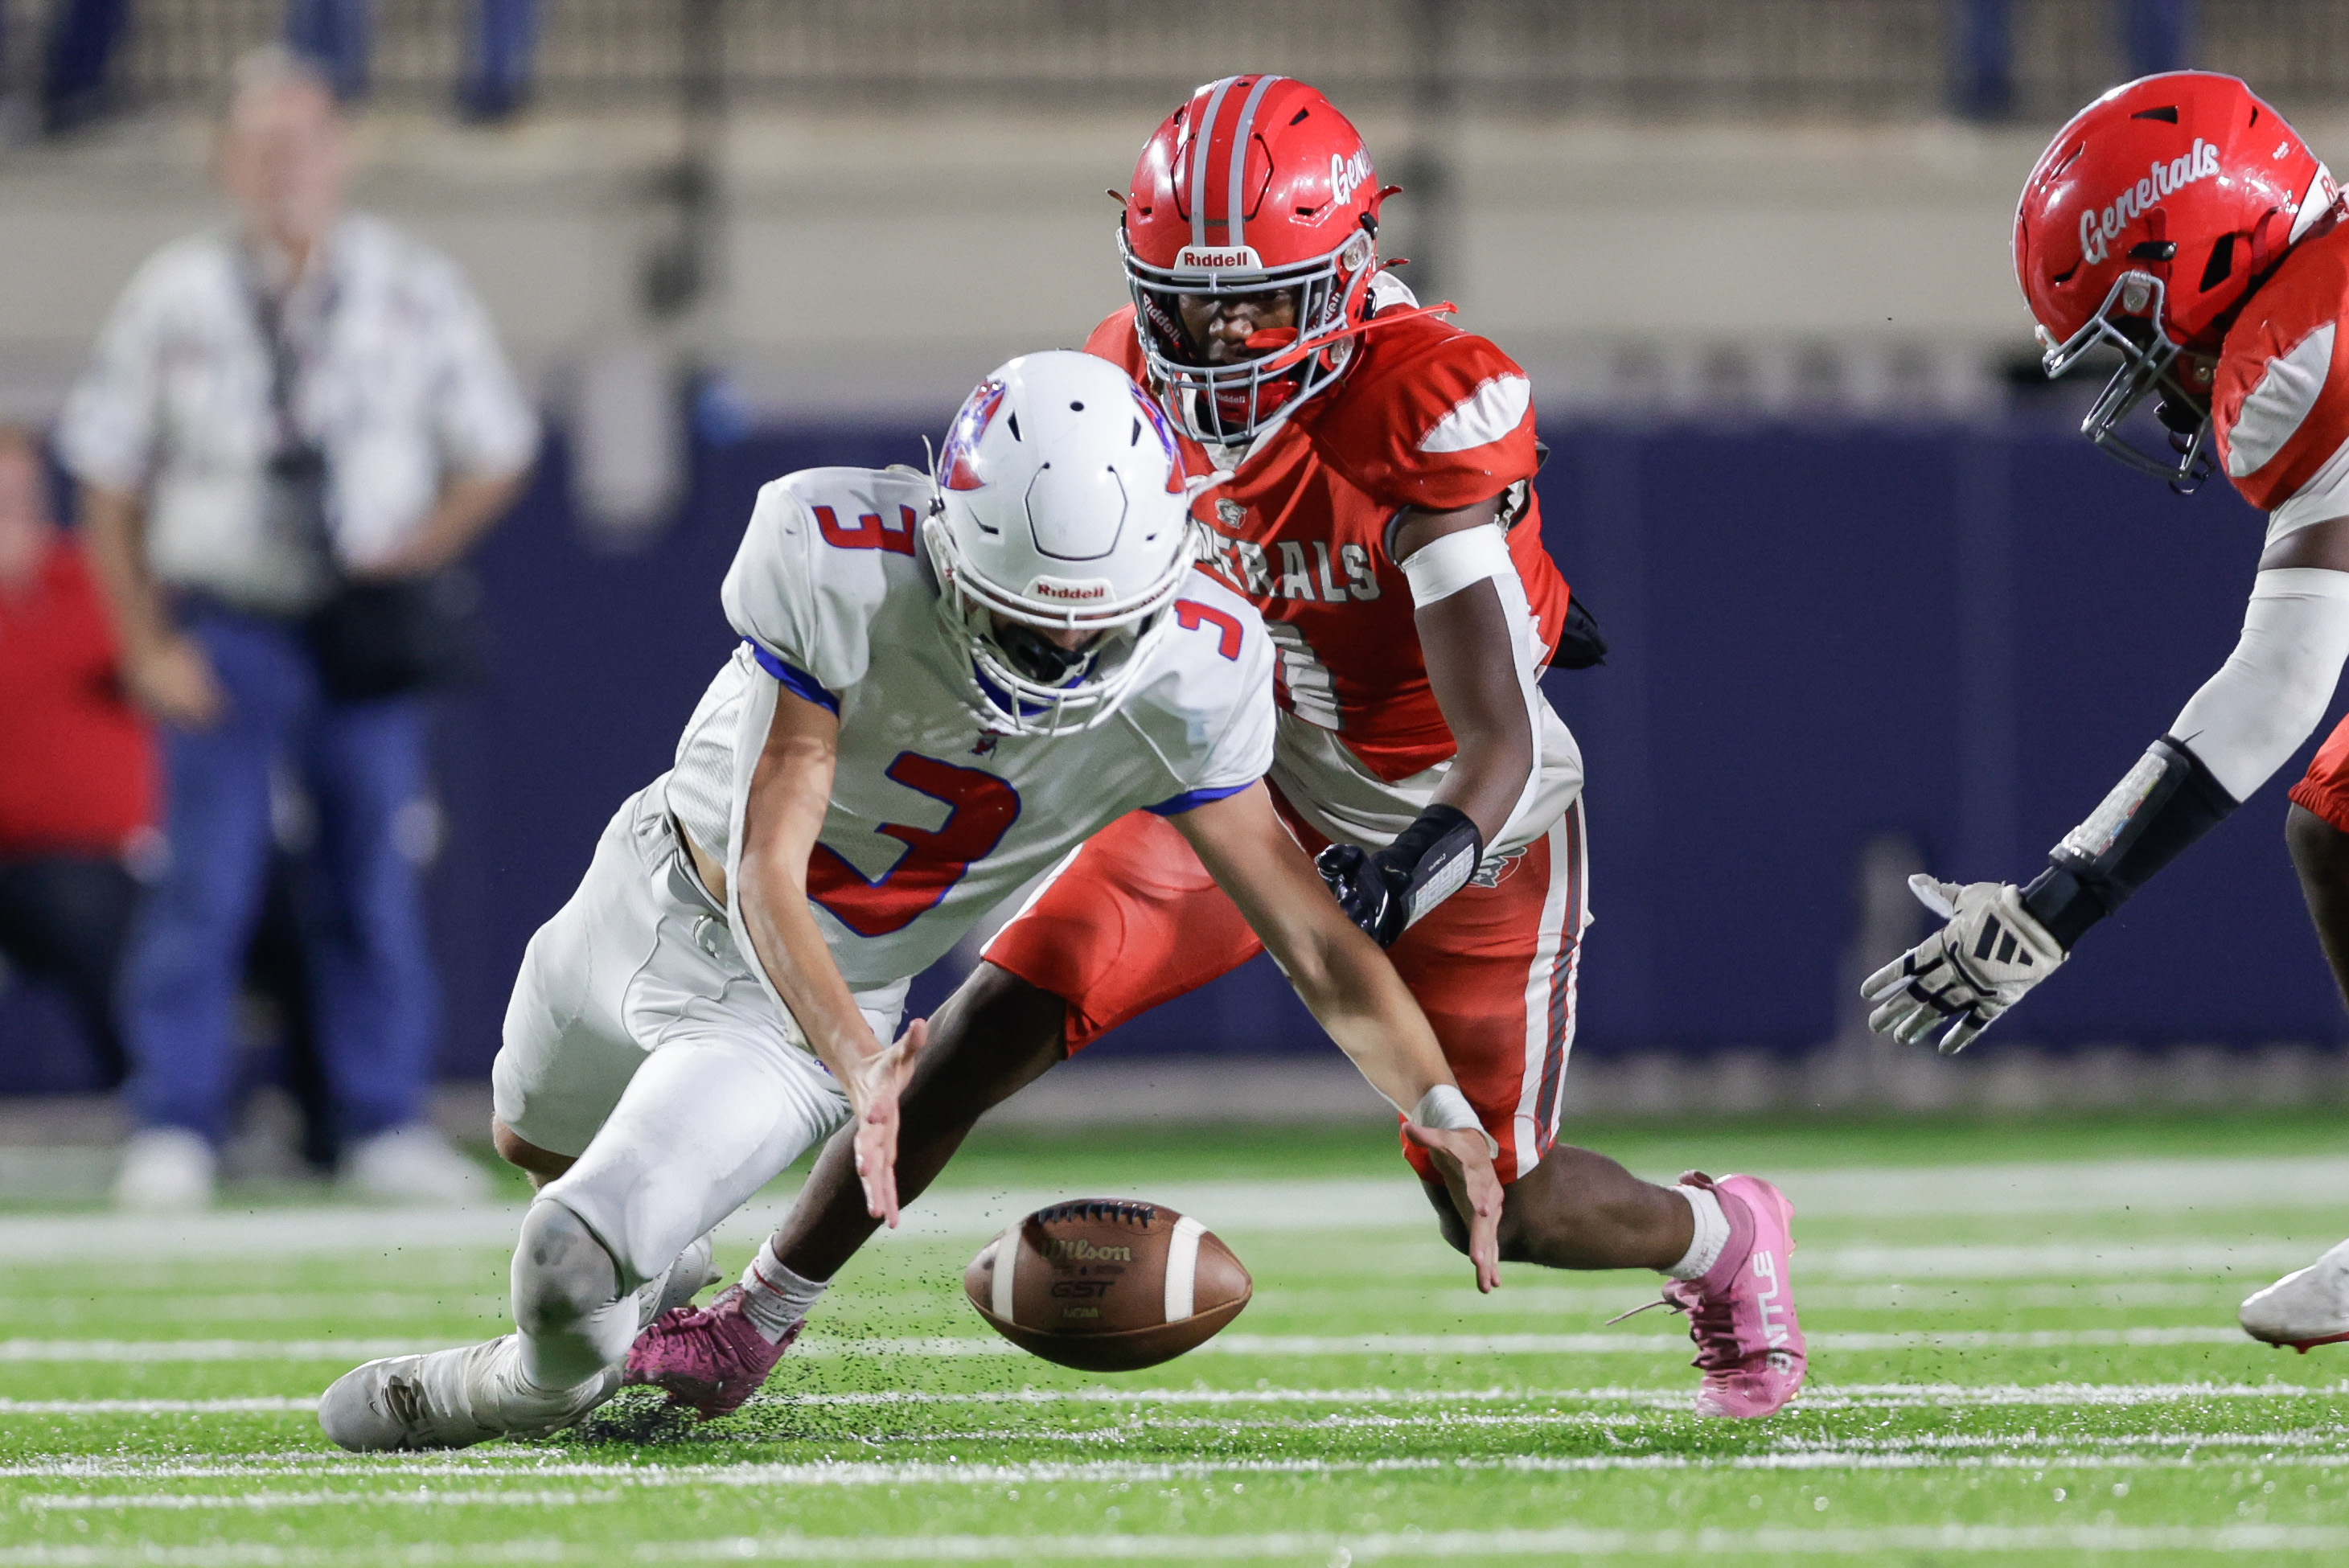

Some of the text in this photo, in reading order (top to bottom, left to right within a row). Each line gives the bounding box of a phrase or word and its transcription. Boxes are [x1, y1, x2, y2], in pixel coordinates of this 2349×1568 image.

[2079, 138, 2220, 265] Generals
[1184, 252, 1247, 267] Riddell
[1143, 292, 1181, 344] Riddell
[811, 503, 917, 557] 3
[1037, 584, 1104, 599] Riddell
[807, 749, 1022, 938] 3
[1042, 1238, 1131, 1262] Wilson
[1050, 1280, 1117, 1299] GST
